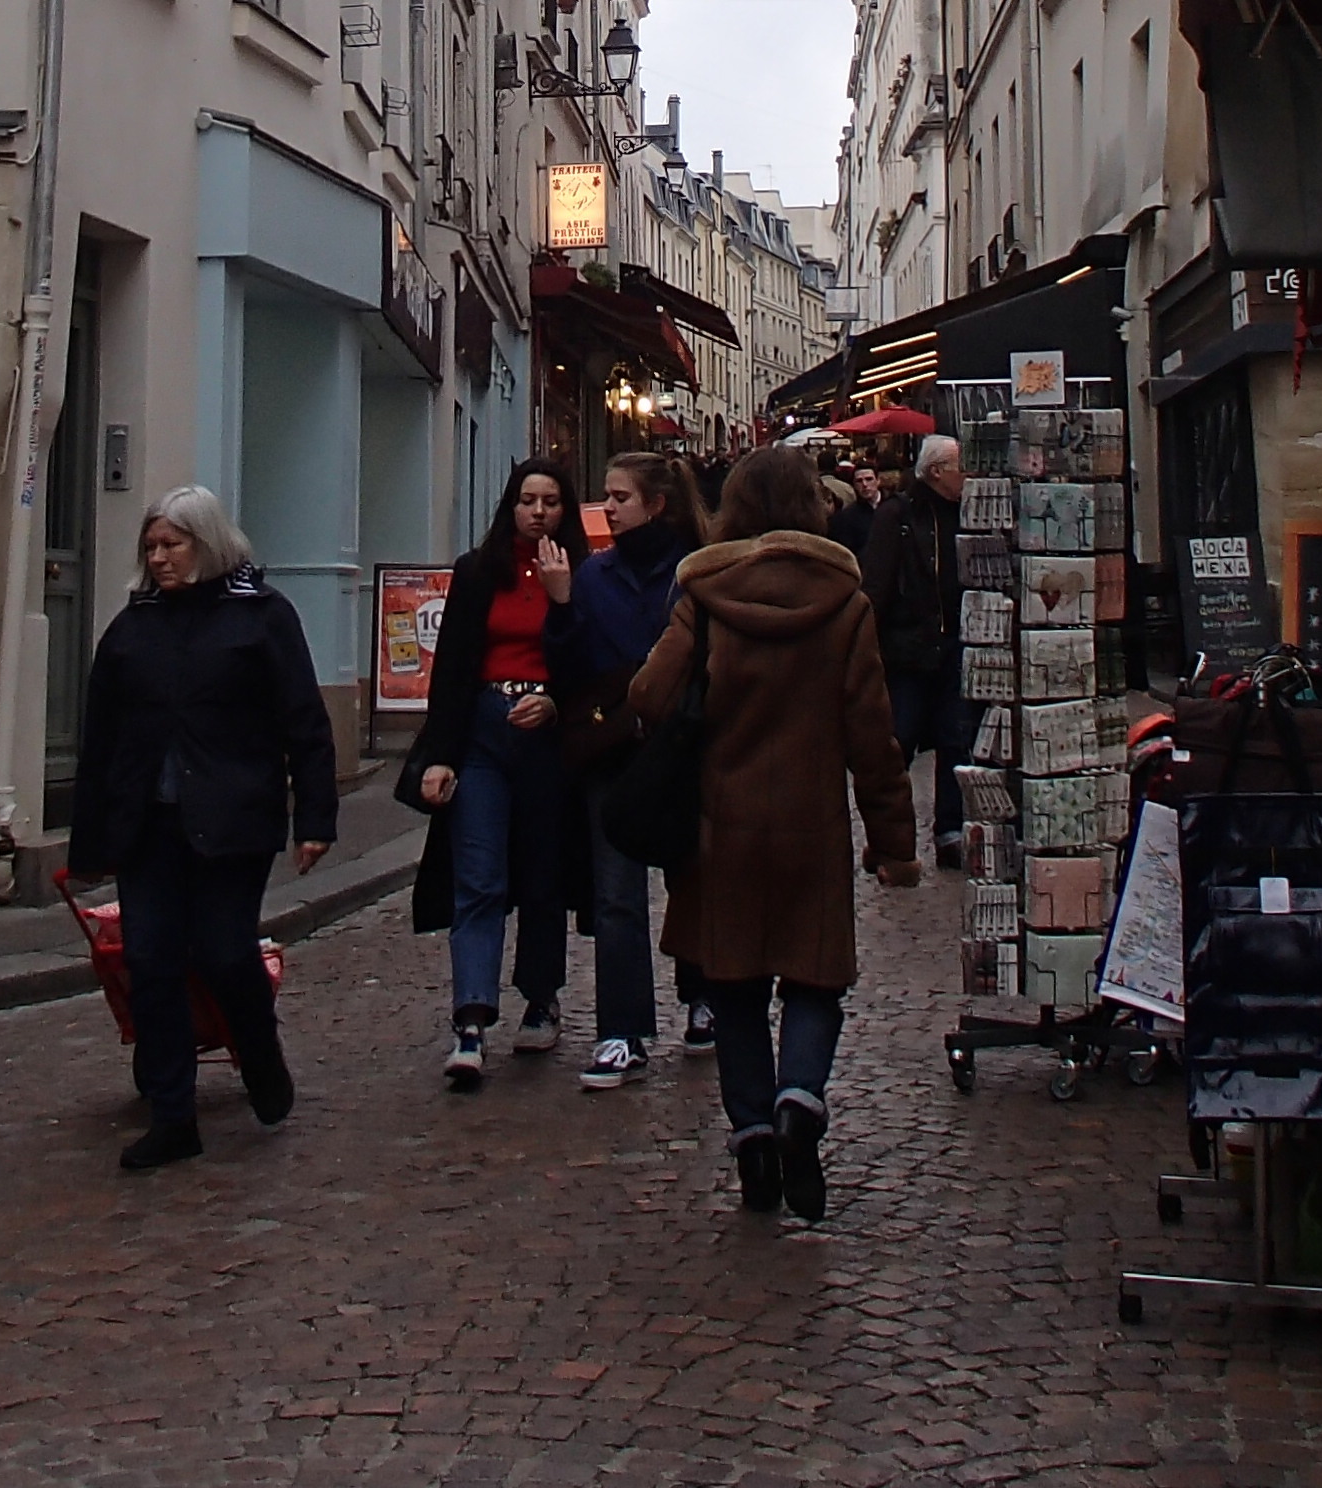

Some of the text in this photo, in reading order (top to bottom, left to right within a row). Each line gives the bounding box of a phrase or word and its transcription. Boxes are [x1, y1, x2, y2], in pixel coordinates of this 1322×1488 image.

[552, 166, 602, 175] TRAITEUR
[567, 220, 589, 228] ASIE
[554, 228, 603, 237] PRESTIGE
[1192, 540, 1246, 556] BOCA
